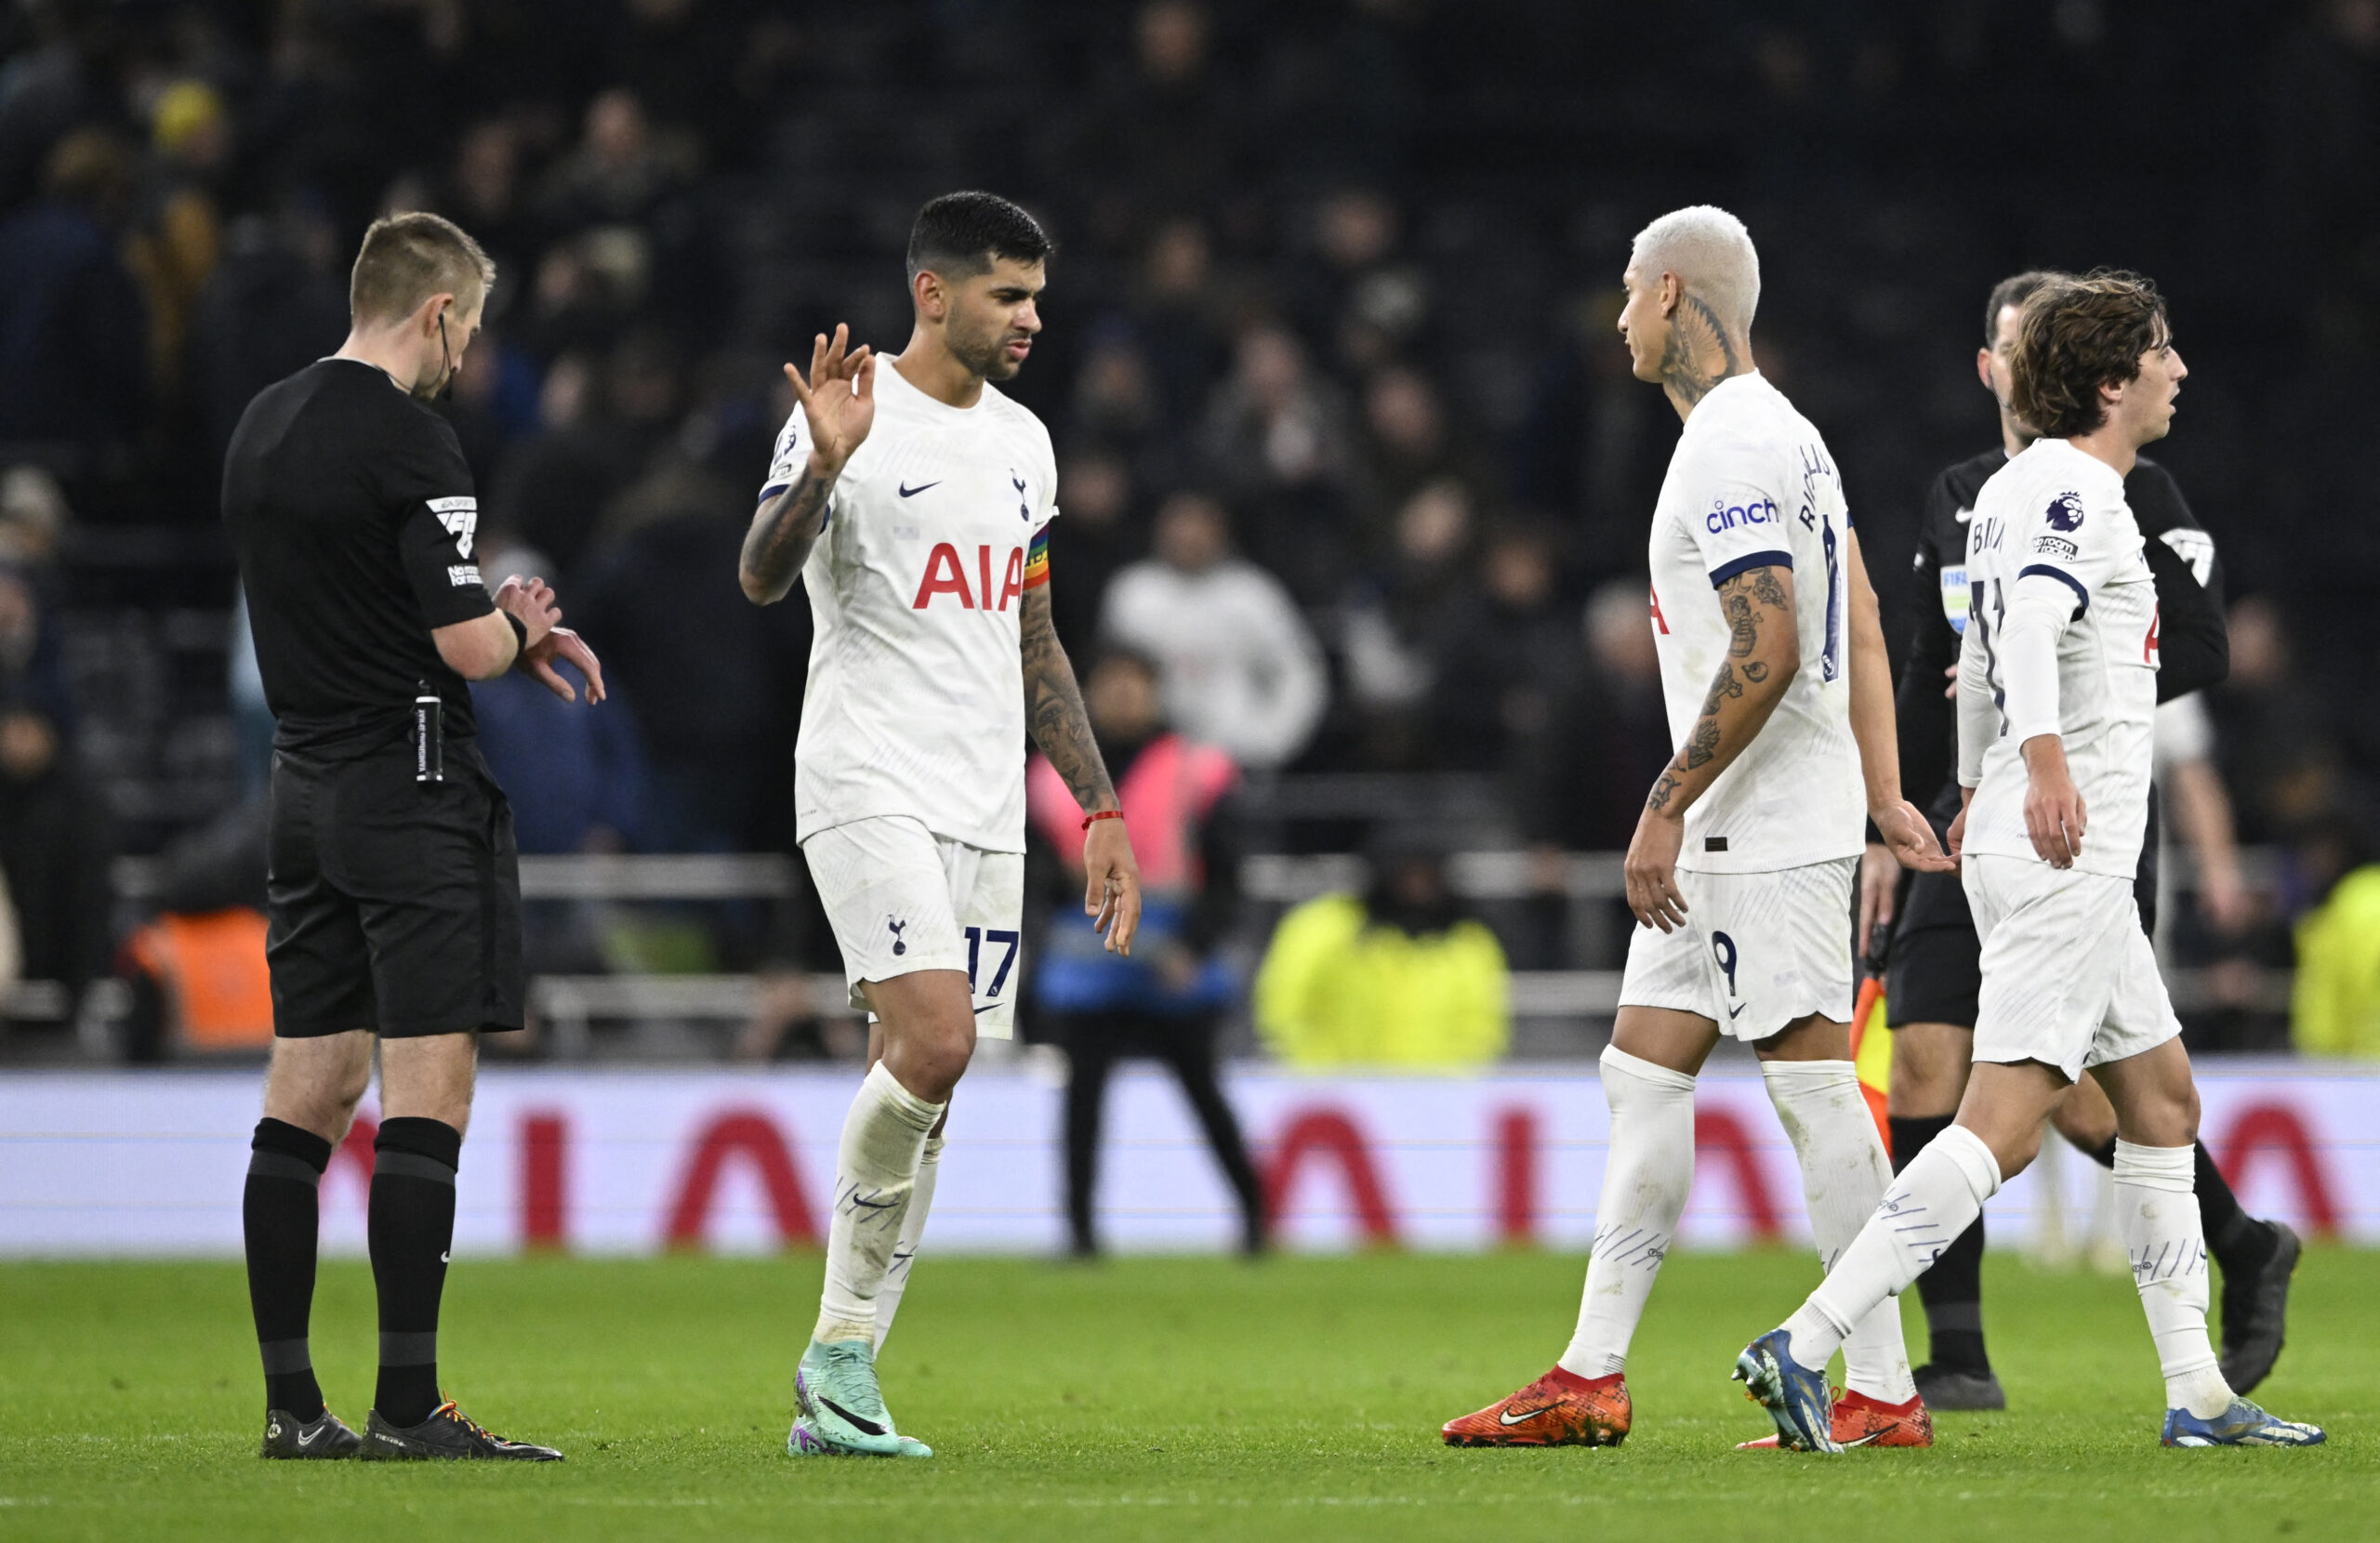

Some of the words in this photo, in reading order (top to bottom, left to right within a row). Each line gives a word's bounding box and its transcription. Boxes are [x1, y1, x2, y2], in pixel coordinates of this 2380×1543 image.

[1706, 499, 1779, 534] cinch
[912, 542, 1024, 612] AIA
[1944, 572, 1968, 587] FIFA
[964, 926, 1020, 997] 17
[1712, 930, 1738, 997] 9
